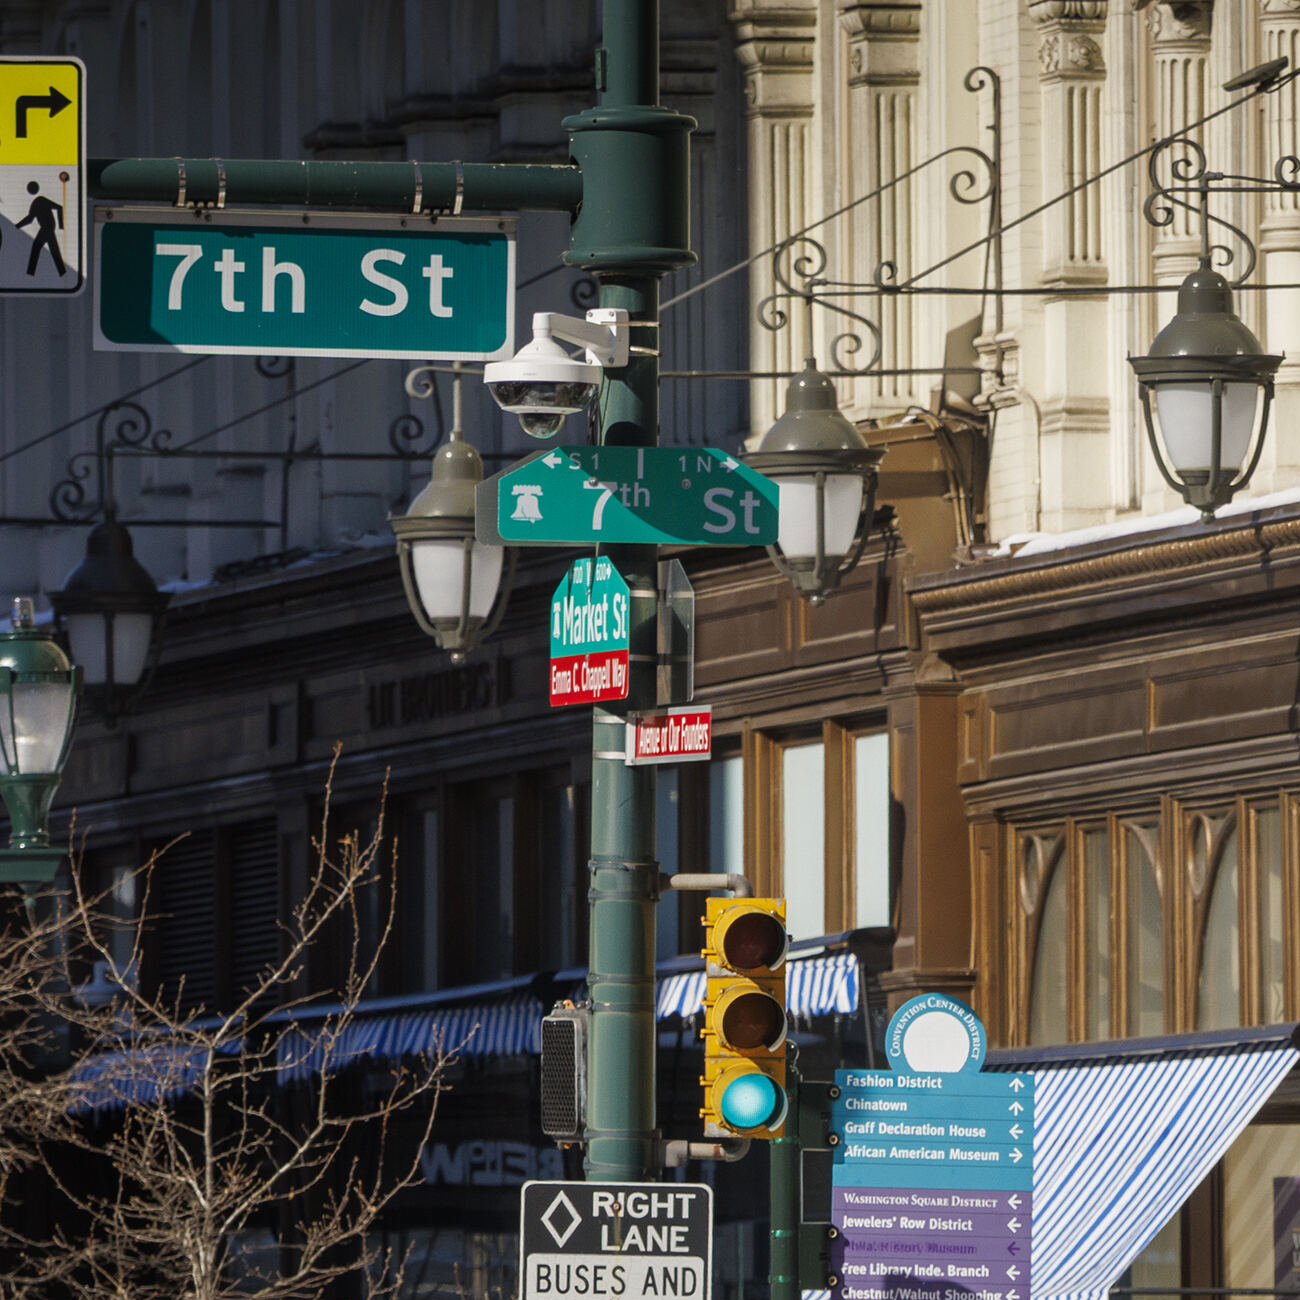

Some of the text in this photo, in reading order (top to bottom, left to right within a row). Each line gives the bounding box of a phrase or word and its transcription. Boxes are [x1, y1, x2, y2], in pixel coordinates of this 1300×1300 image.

[155, 243, 454, 318] 7th St
[568, 452, 600, 470] S 1
[679, 456, 712, 473] 1 N
[583, 480, 761, 535] 7th St
[563, 592, 627, 646] Market St
[552, 658, 627, 698] Emma C. Chappell Way
[668, 717, 680, 752] Our
[681, 716, 709, 751] Founders
[890, 997, 980, 1060] CONVENTION CENTER DISTRICT
[846, 1075, 943, 1089] Fashion District
[845, 1098, 908, 1111] Chinatown
[844, 1121, 986, 1138] Graff Declaration House
[844, 1145, 1000, 1161] African American Museum
[592, 1191, 697, 1219] RIGHT
[843, 1192, 998, 1208] WASHINGTON SQUARE DISTRICT
[842, 1215, 973, 1231] Jewelers' Row District
[601, 1224, 690, 1253] LANE
[536, 1263, 697, 1297] BUSES AND
[841, 1262, 990, 1279] Free Library Inde. Branch
